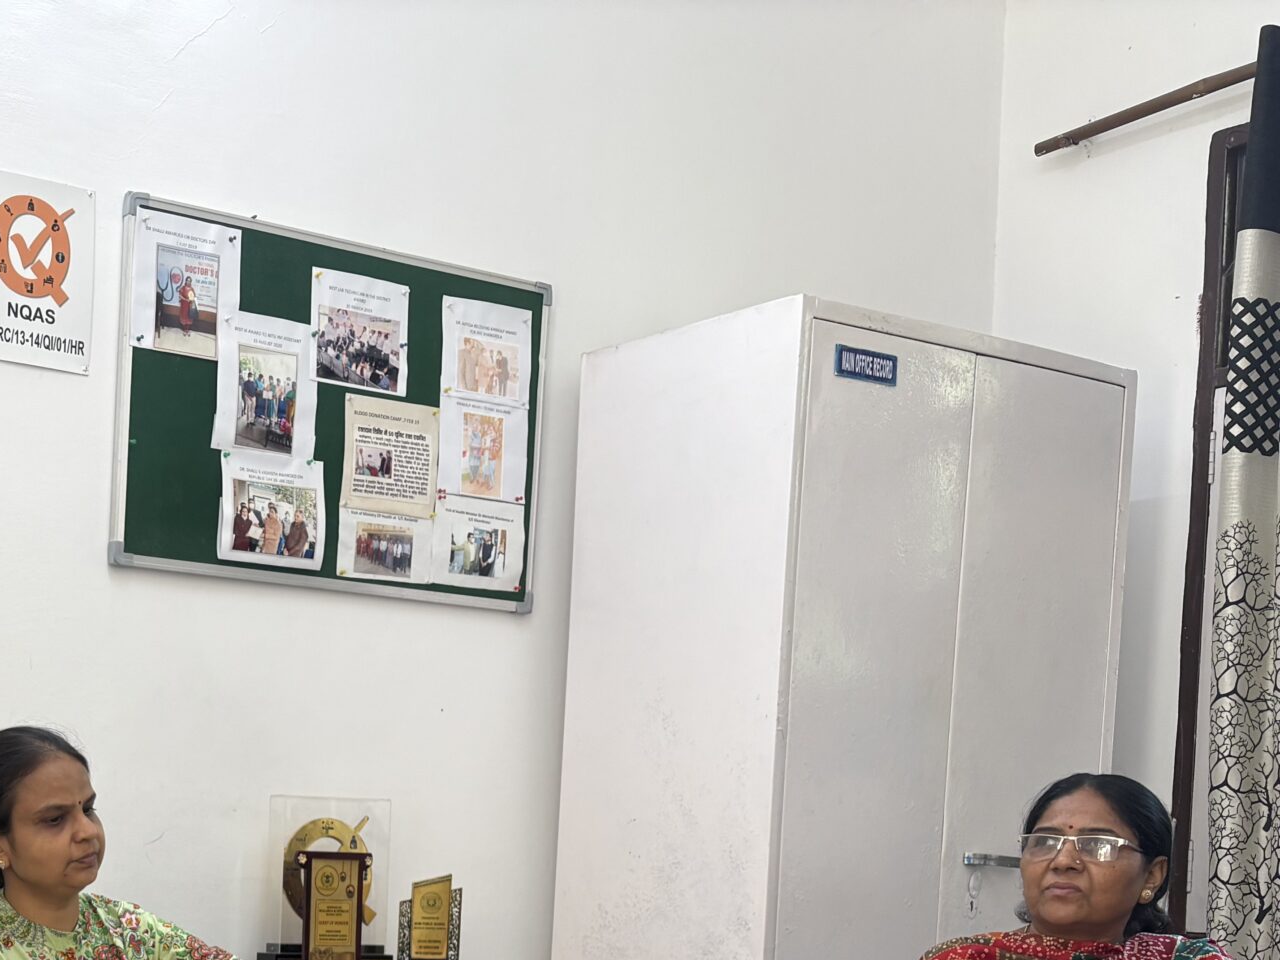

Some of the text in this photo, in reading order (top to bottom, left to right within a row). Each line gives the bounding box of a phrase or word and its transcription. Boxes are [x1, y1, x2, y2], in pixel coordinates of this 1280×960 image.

[185, 265, 214, 277] DOCTOR'S
[7, 302, 55, 324] NQAS
[842, 351, 893, 379] MAIN OFFICE RECORD
